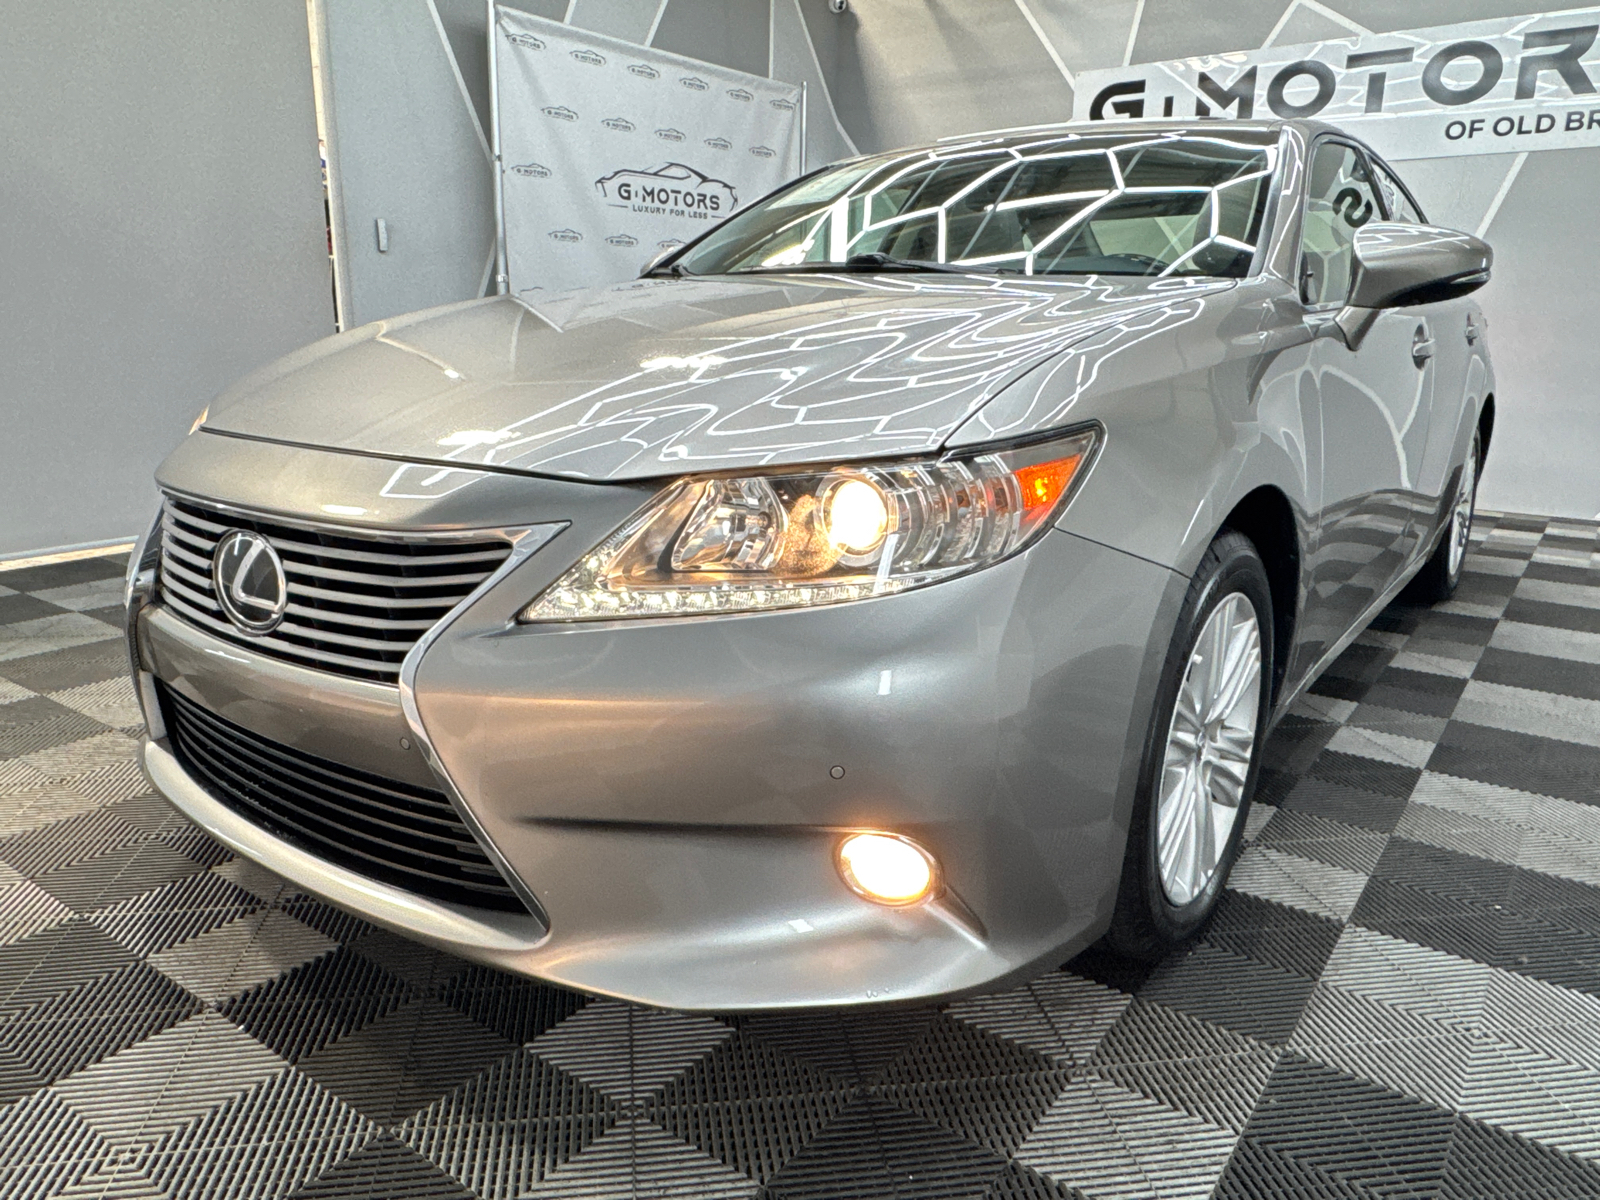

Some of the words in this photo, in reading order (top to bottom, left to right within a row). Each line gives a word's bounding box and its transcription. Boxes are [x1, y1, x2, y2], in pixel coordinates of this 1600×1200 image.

[1445, 119, 1486, 140] OF
[1492, 113, 1556, 137] OLD
[632, 204, 667, 215] LUXURY
[670, 208, 686, 217] FOR
[688, 211, 708, 220] LESS
